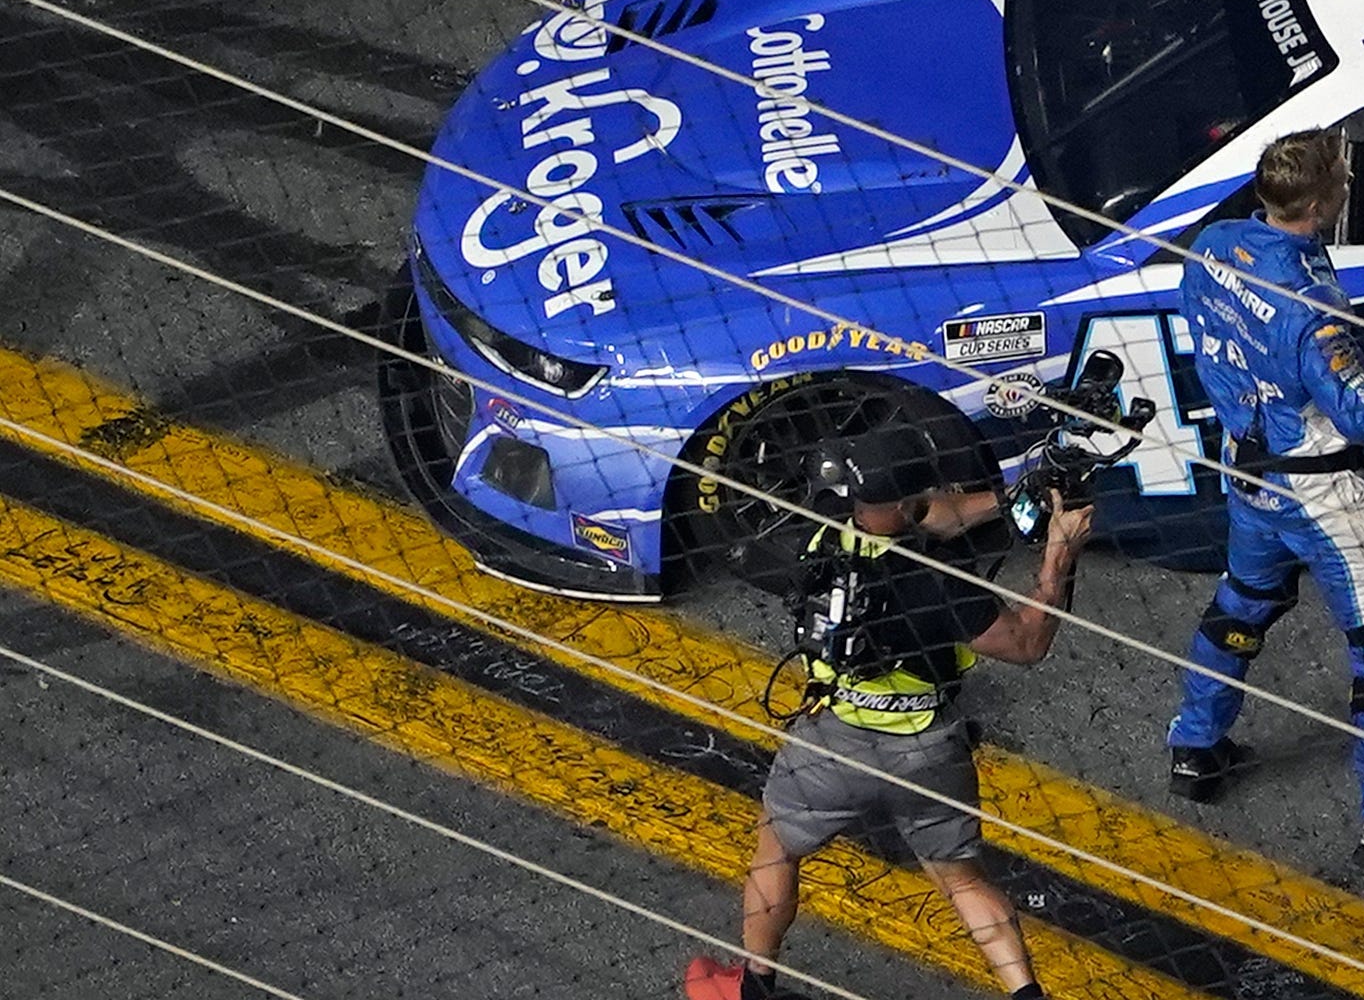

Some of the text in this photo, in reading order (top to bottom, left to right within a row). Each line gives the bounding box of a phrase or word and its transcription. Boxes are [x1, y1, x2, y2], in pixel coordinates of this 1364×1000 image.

[747, 13, 841, 195] Cottonelle
[461, 66, 683, 319] Kroger
[976, 317, 1030, 336] NASCAR
[960, 336, 1032, 356] CUP SERIES
[575, 525, 627, 551] SUNOCO
